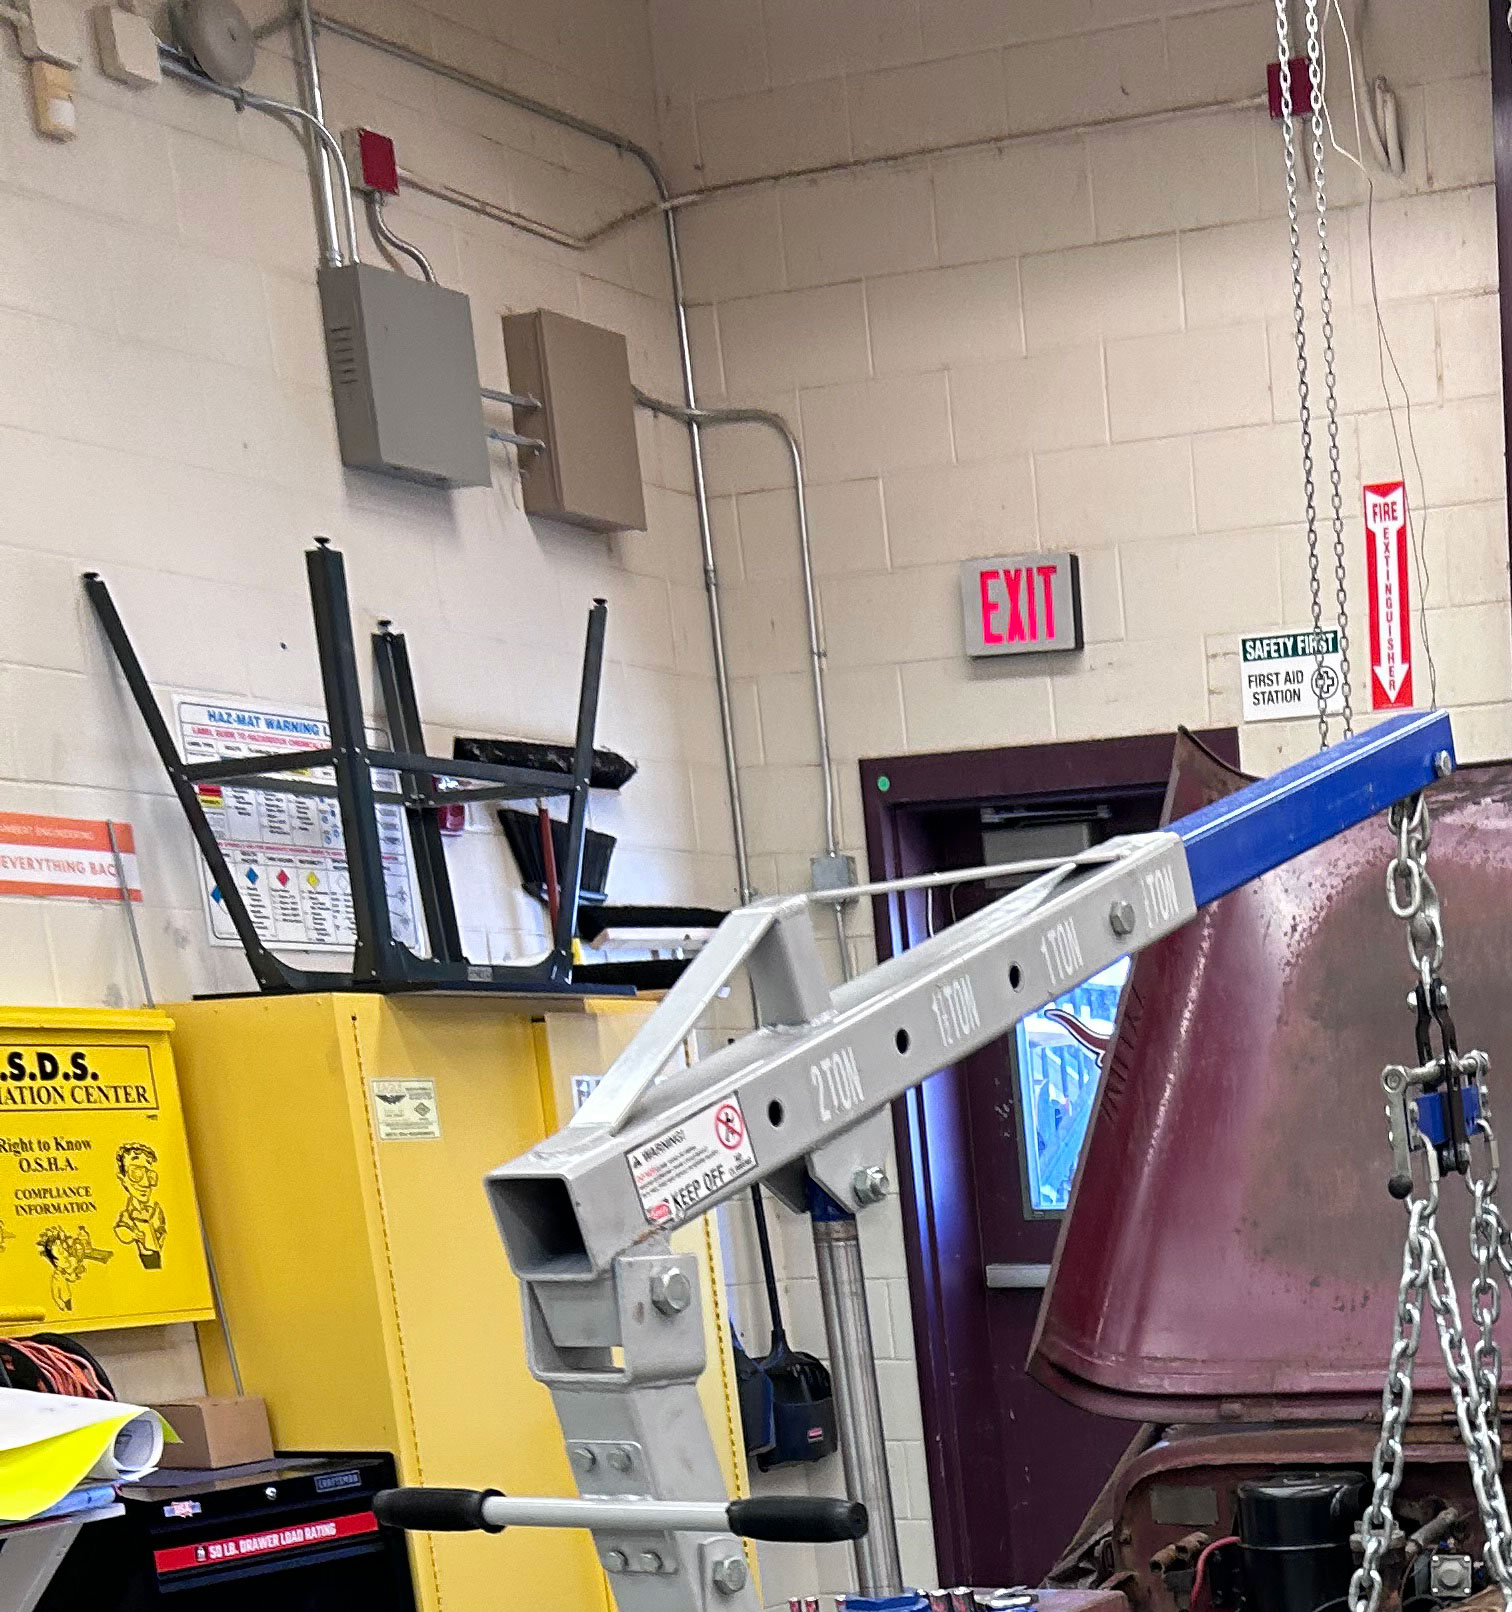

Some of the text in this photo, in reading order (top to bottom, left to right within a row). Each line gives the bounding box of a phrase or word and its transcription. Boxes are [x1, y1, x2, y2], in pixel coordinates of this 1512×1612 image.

[1372, 501, 1398, 523] FIRE
[980, 565, 1057, 645] EXIT
[1383, 527, 1396, 692] EXTINGUISHER
[1245, 636, 1294, 660] SAFETY
[1248, 670, 1304, 688] FIRST AID
[1252, 688, 1301, 706] STATION
[207, 709, 261, 728] HAZ-MAT
[264, 717, 320, 736] WARNING
[1, 855, 119, 877] EVERYTHING BAC
[71, 1085, 150, 1104] CENTER
[37, 1138, 51, 1151] to
[53, 1136, 92, 1151] Know
[18, 1157, 79, 1173] O.S.H.A.
[15, 1185, 92, 1201] COMPLIANCE
[670, 1179, 702, 1209] KEEP
[702, 1164, 726, 1192] OFF
[15, 1201, 97, 1217] INFORMATION
[239, 1533, 280, 1553] DRAWER
[280, 1528, 304, 1545] LOAD
[304, 1522, 336, 1540] RATING
